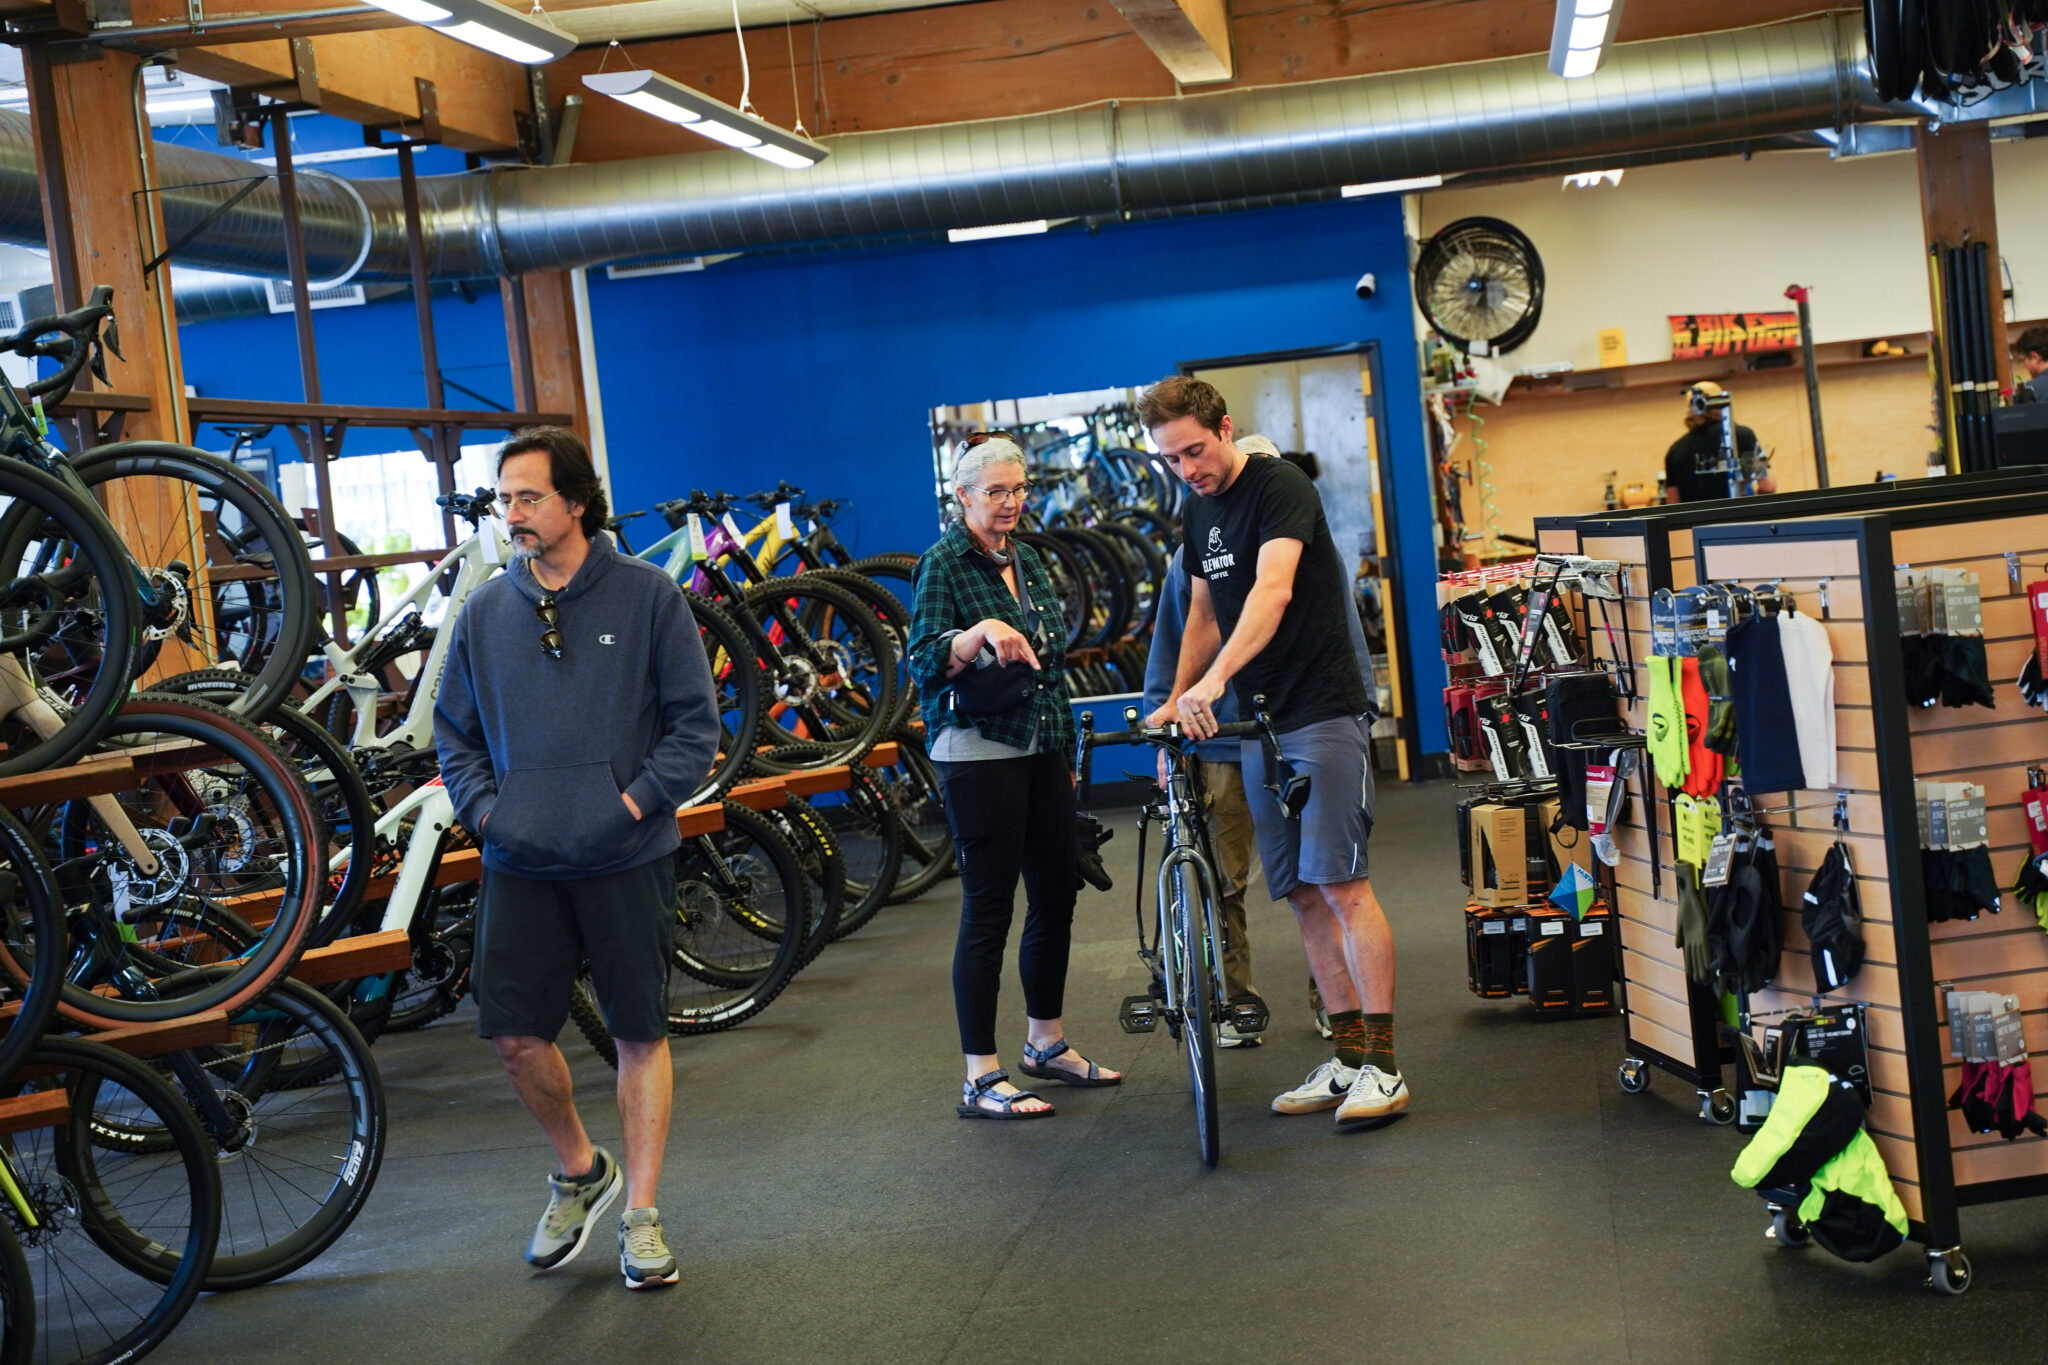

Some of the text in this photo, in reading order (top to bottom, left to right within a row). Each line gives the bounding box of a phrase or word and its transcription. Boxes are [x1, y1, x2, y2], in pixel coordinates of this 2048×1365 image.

[1202, 553, 1235, 573] ELEVATOR
[799, 813, 833, 856] MAXXIS
[682, 1008, 697, 1016] DT
[699, 1004, 724, 1016] SWISS
[90, 1122, 145, 1141] MAXXI
